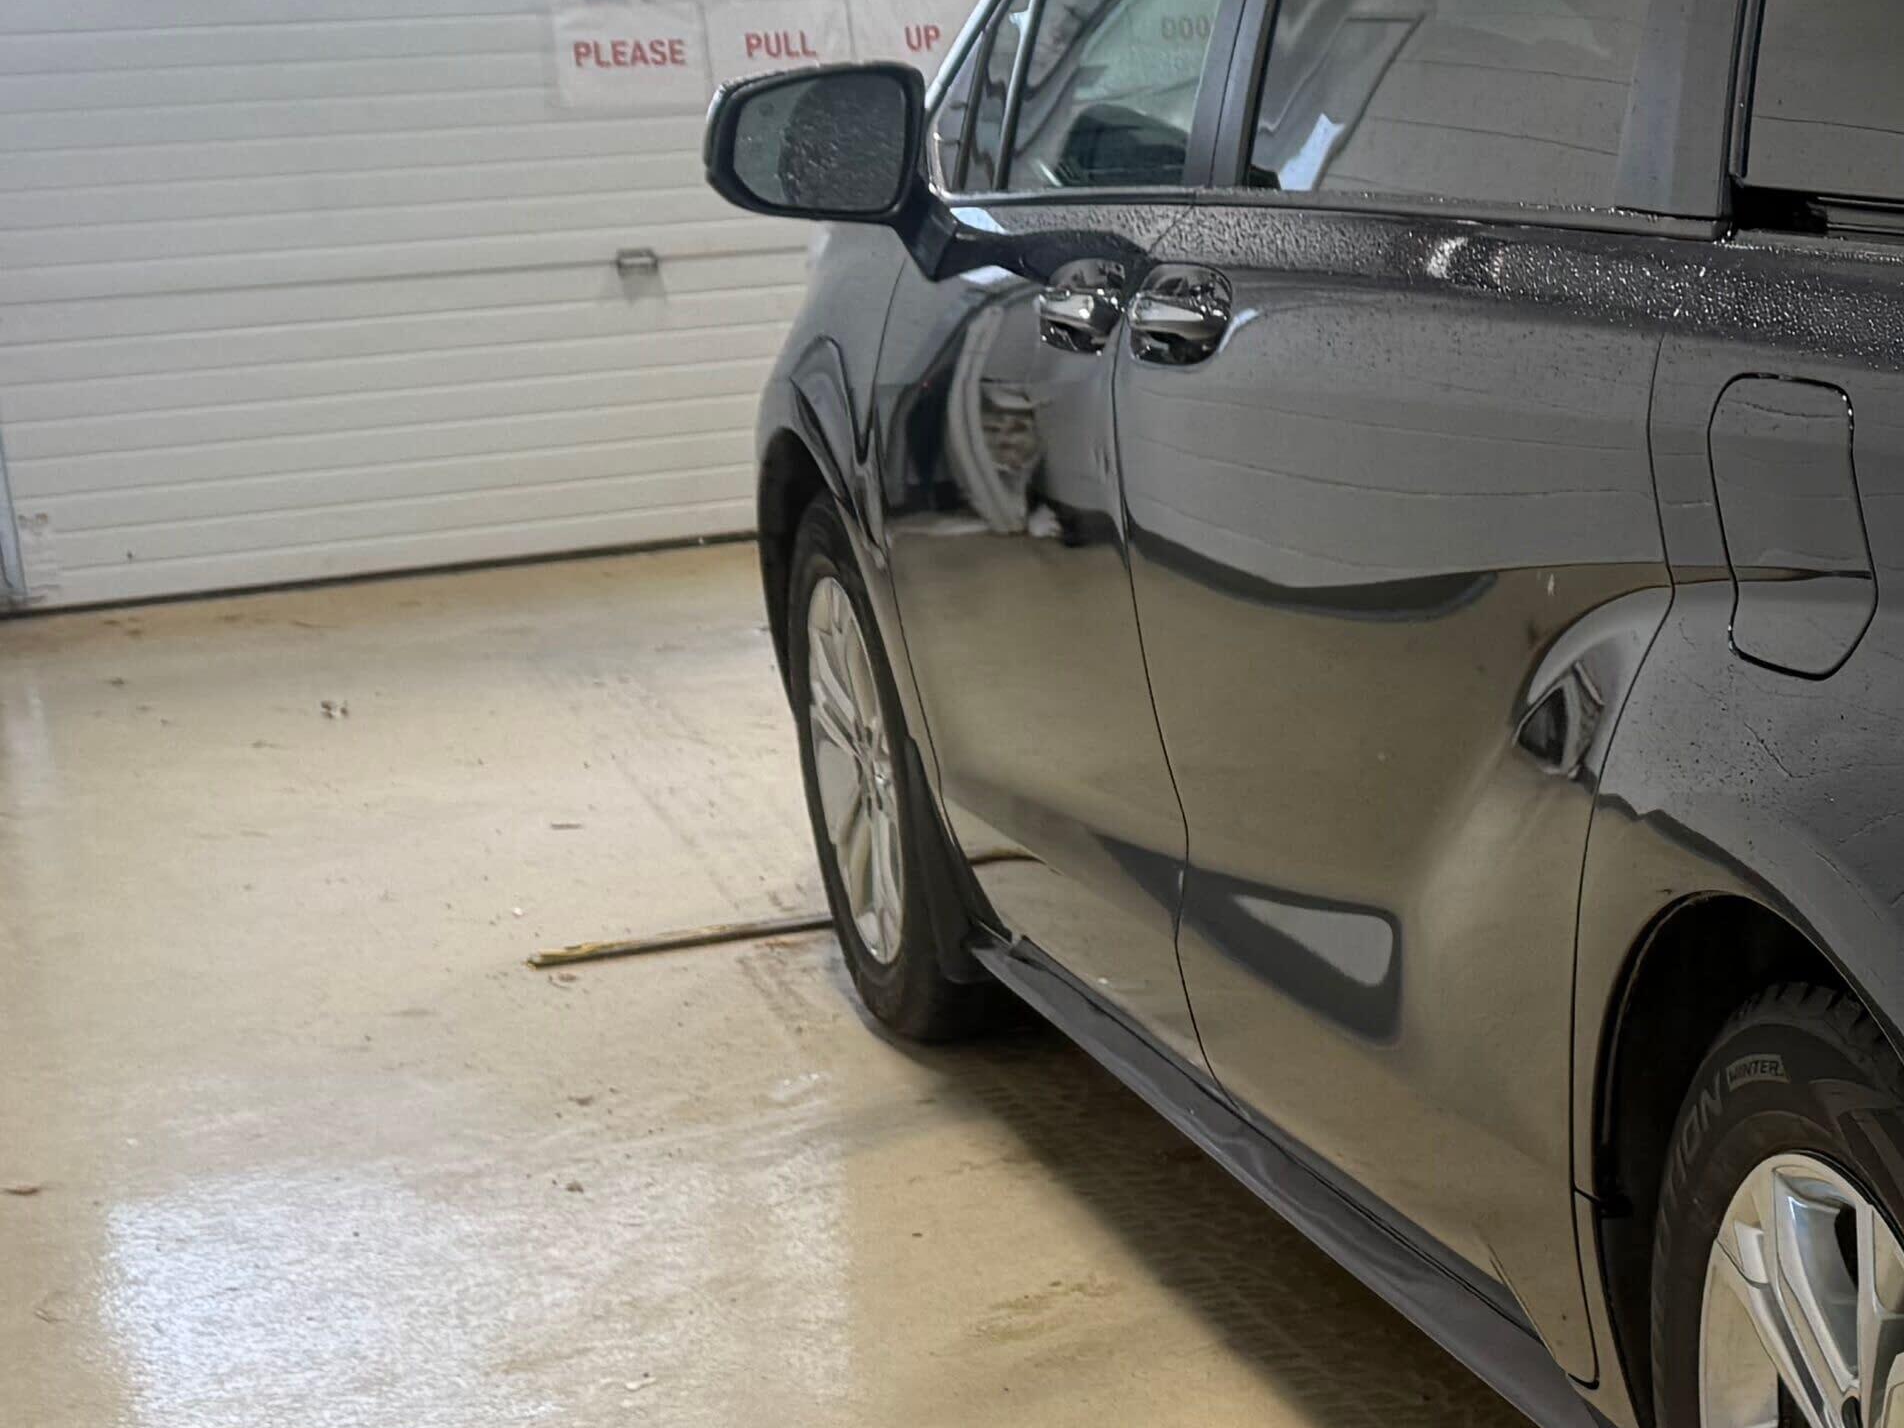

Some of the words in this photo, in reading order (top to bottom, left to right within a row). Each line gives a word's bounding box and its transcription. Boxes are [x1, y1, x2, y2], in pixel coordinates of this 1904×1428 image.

[573, 38, 687, 69] PLEASE
[745, 31, 817, 59] PULL
[905, 24, 941, 52] UP
[1162, 15, 1209, 40] DOO
